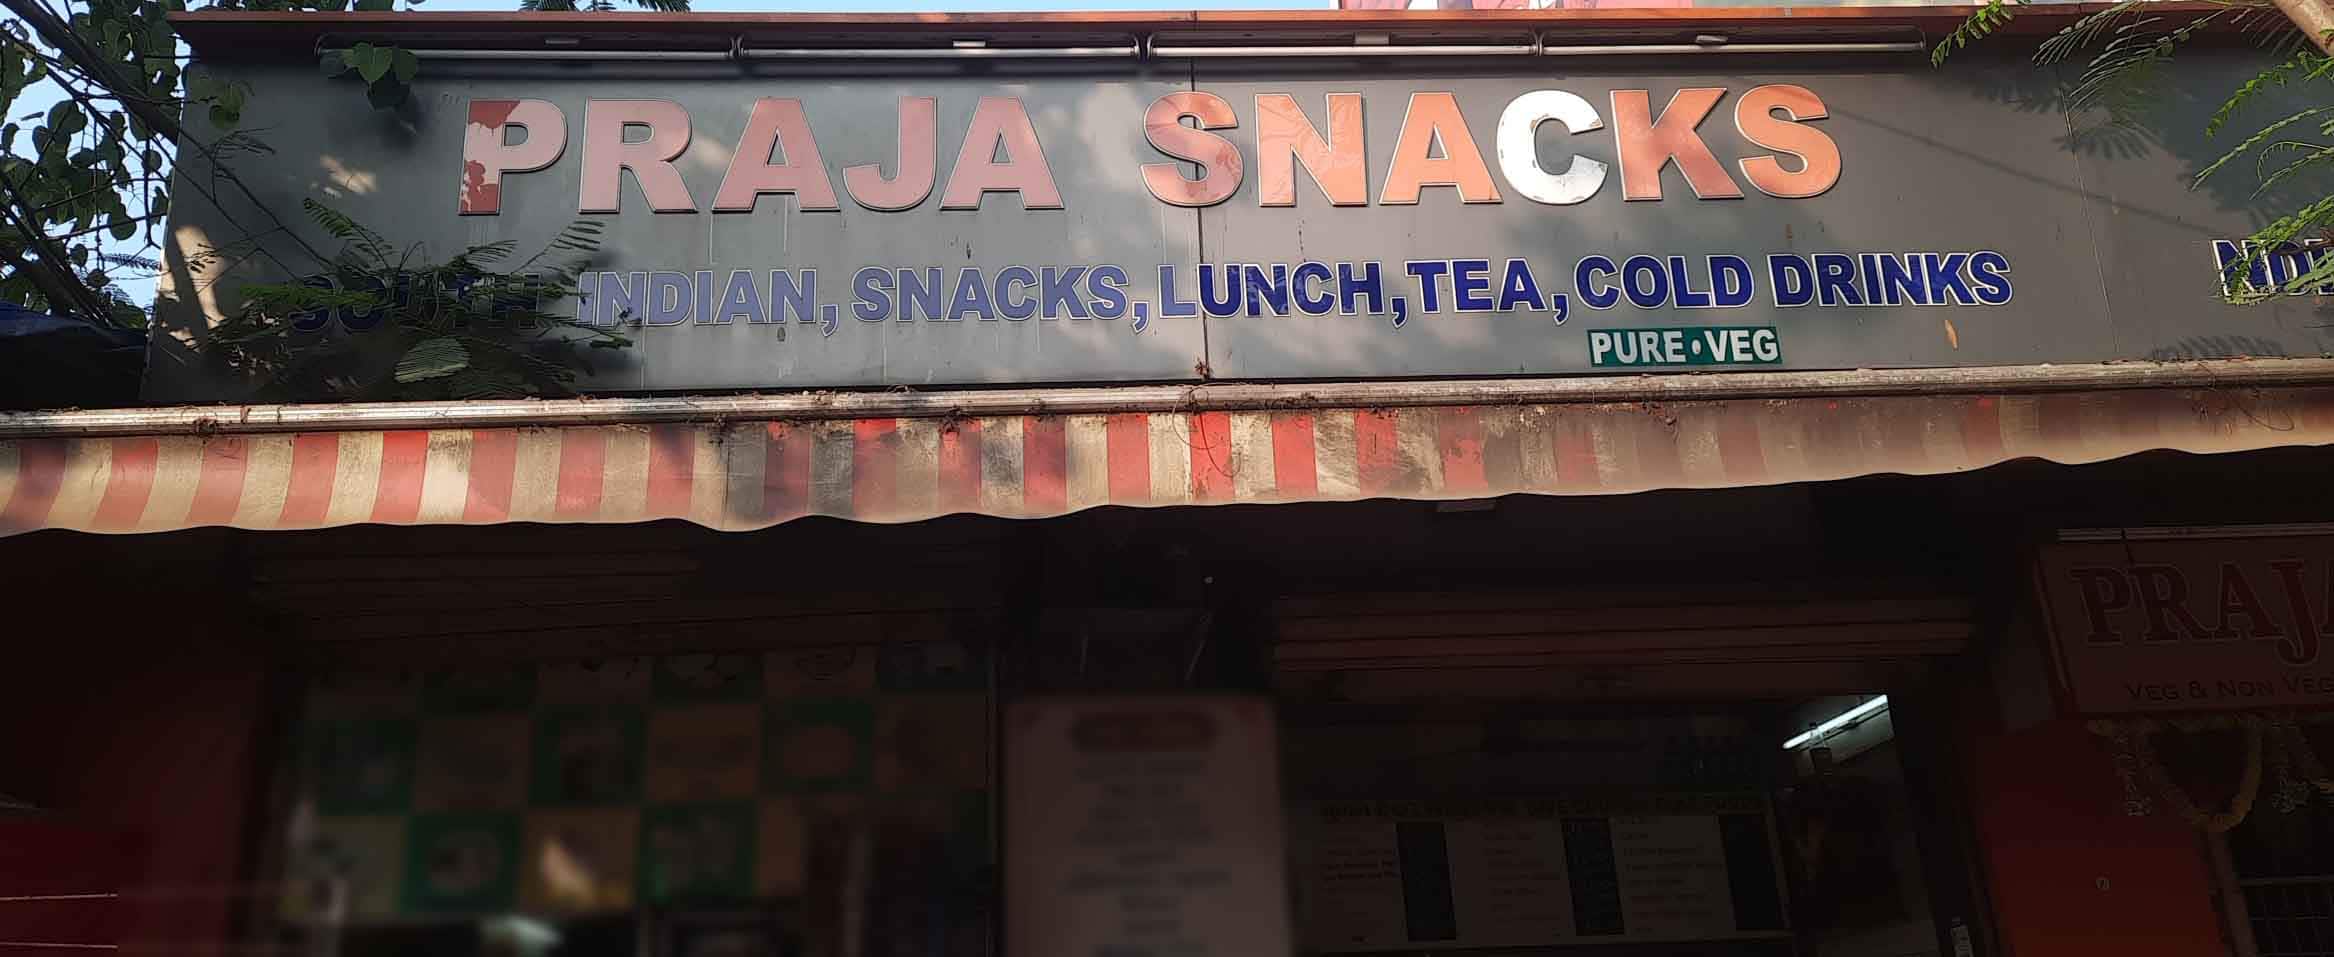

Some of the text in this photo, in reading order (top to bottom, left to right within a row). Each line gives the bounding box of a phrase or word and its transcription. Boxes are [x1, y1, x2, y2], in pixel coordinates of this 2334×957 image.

[457, 85, 1843, 216] PRAJA SNACKS
[575, 267, 840, 336] INDIAN,
[850, 264, 1150, 335] SNACKS,
[1157, 261, 1408, 328] LUNCH,
[1406, 258, 1571, 325] TEA,
[1573, 254, 1755, 309] COLD
[1774, 251, 2013, 307] DRINKS
